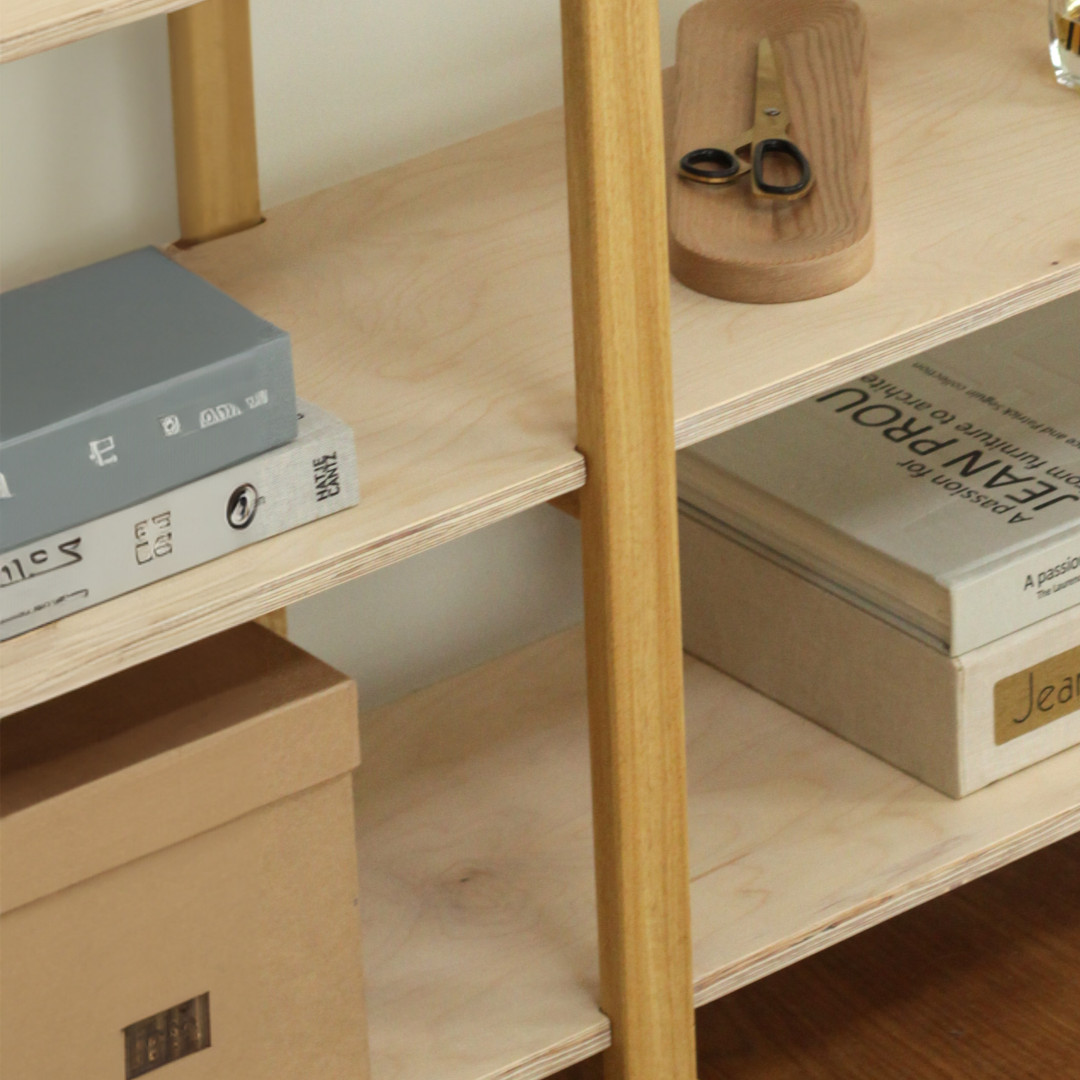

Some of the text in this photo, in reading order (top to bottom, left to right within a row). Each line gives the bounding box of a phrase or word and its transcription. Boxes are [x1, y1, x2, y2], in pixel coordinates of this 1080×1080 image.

[930, 409, 957, 425] to
[1002, 406, 1044, 434] Patrick
[955, 422, 1047, 471] furniture
[1040, 425, 1067, 440] and
[896, 459, 1034, 524] A passion for
[941, 449, 1080, 511] JEAN
[1023, 571, 1035, 591] A
